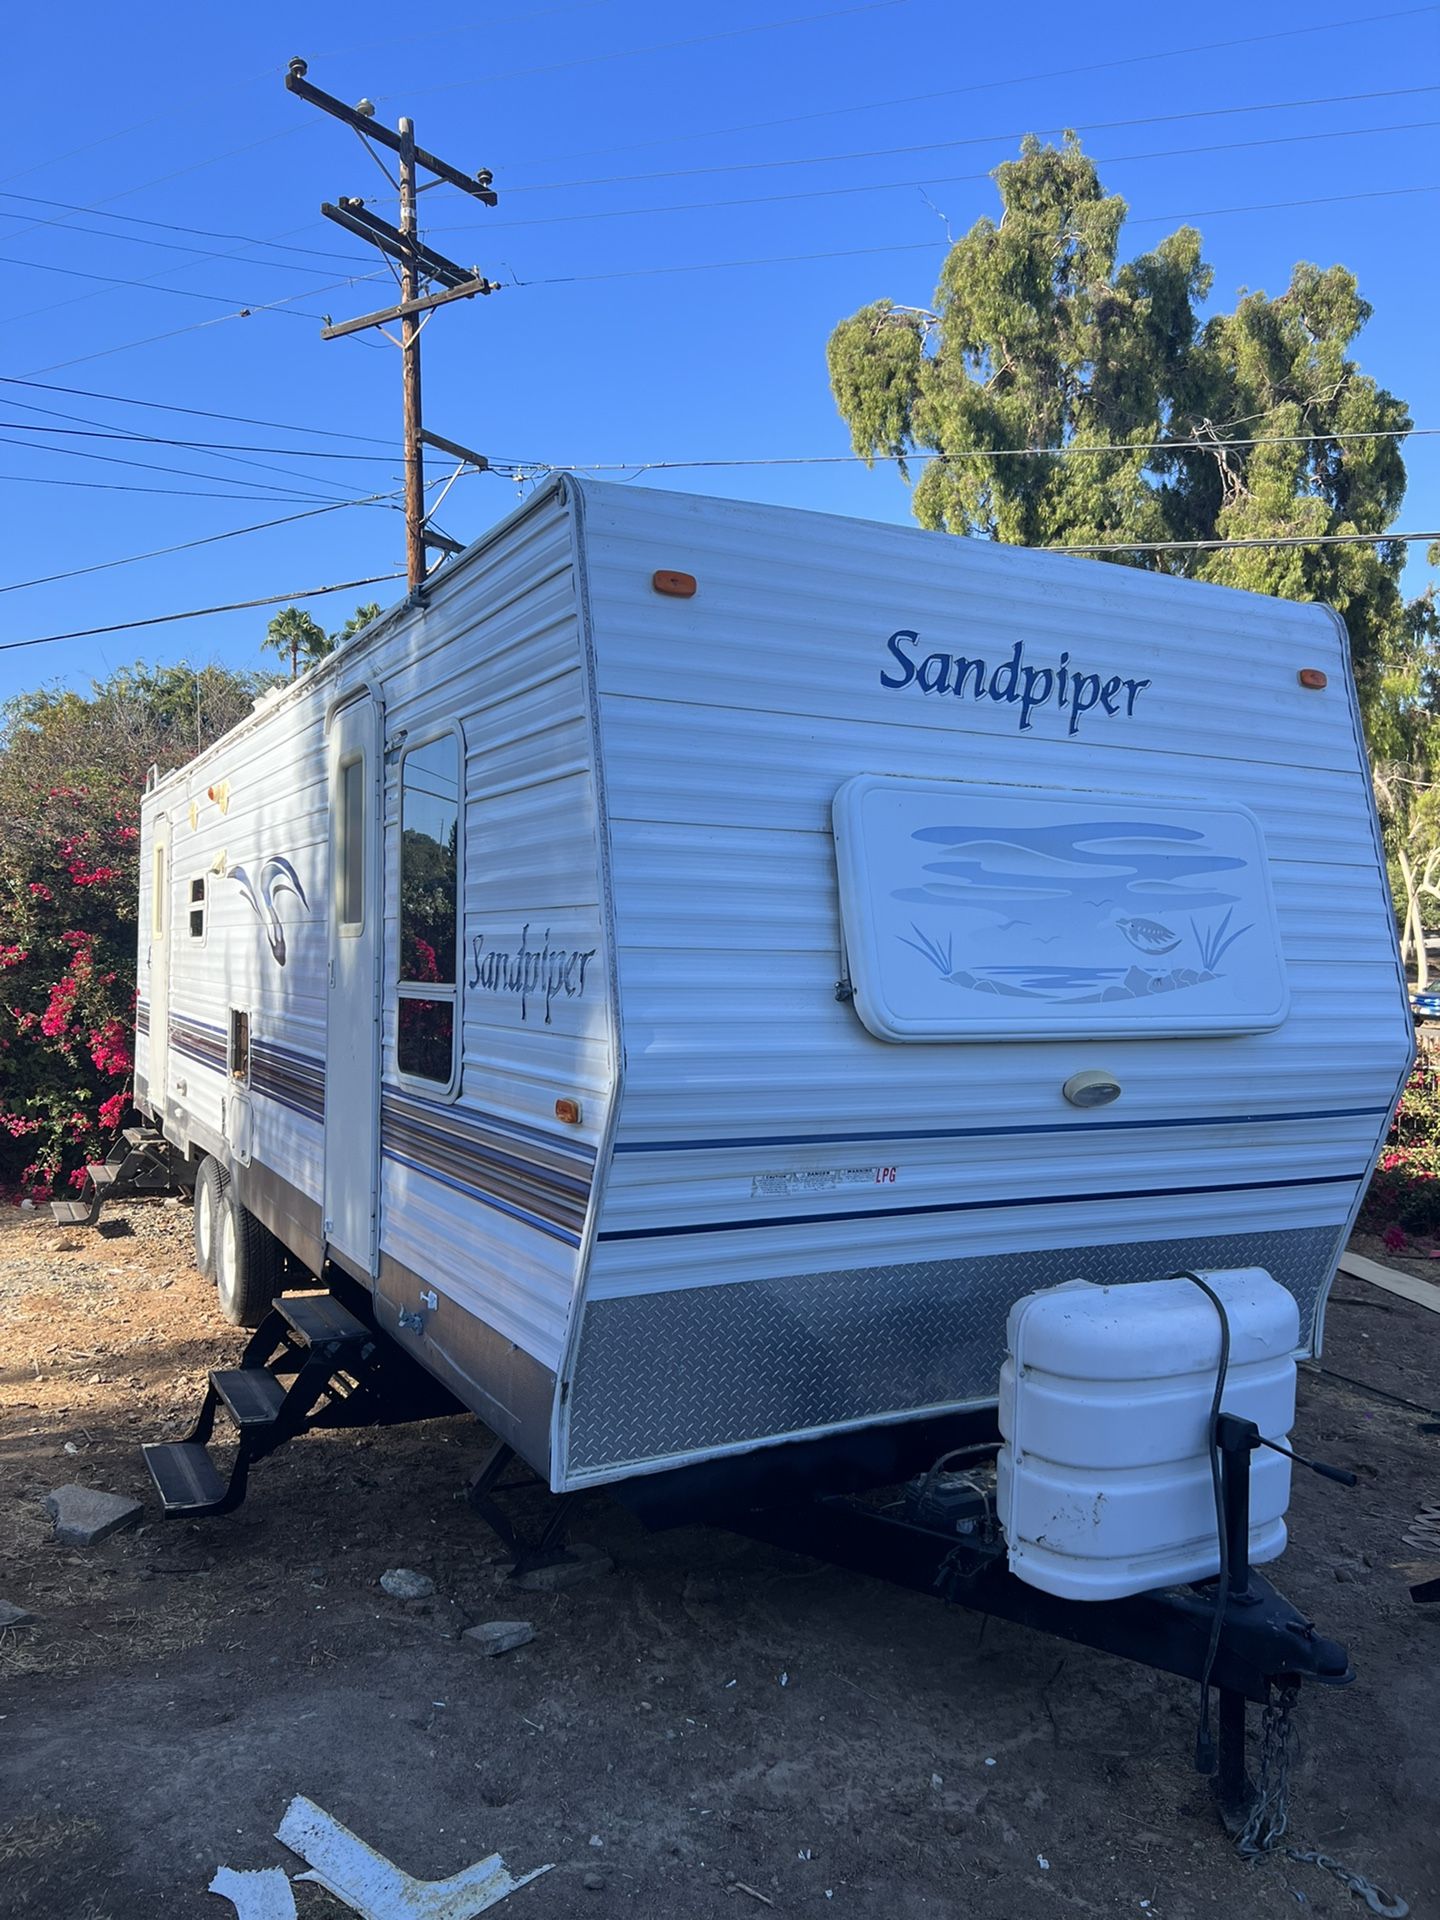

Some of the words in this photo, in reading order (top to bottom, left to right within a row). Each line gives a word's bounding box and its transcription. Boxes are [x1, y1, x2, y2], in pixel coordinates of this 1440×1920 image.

[880, 630, 1151, 736] Sandpiper
[468, 923, 596, 1024] Sandpiper
[875, 1167, 897, 1184] LPG
